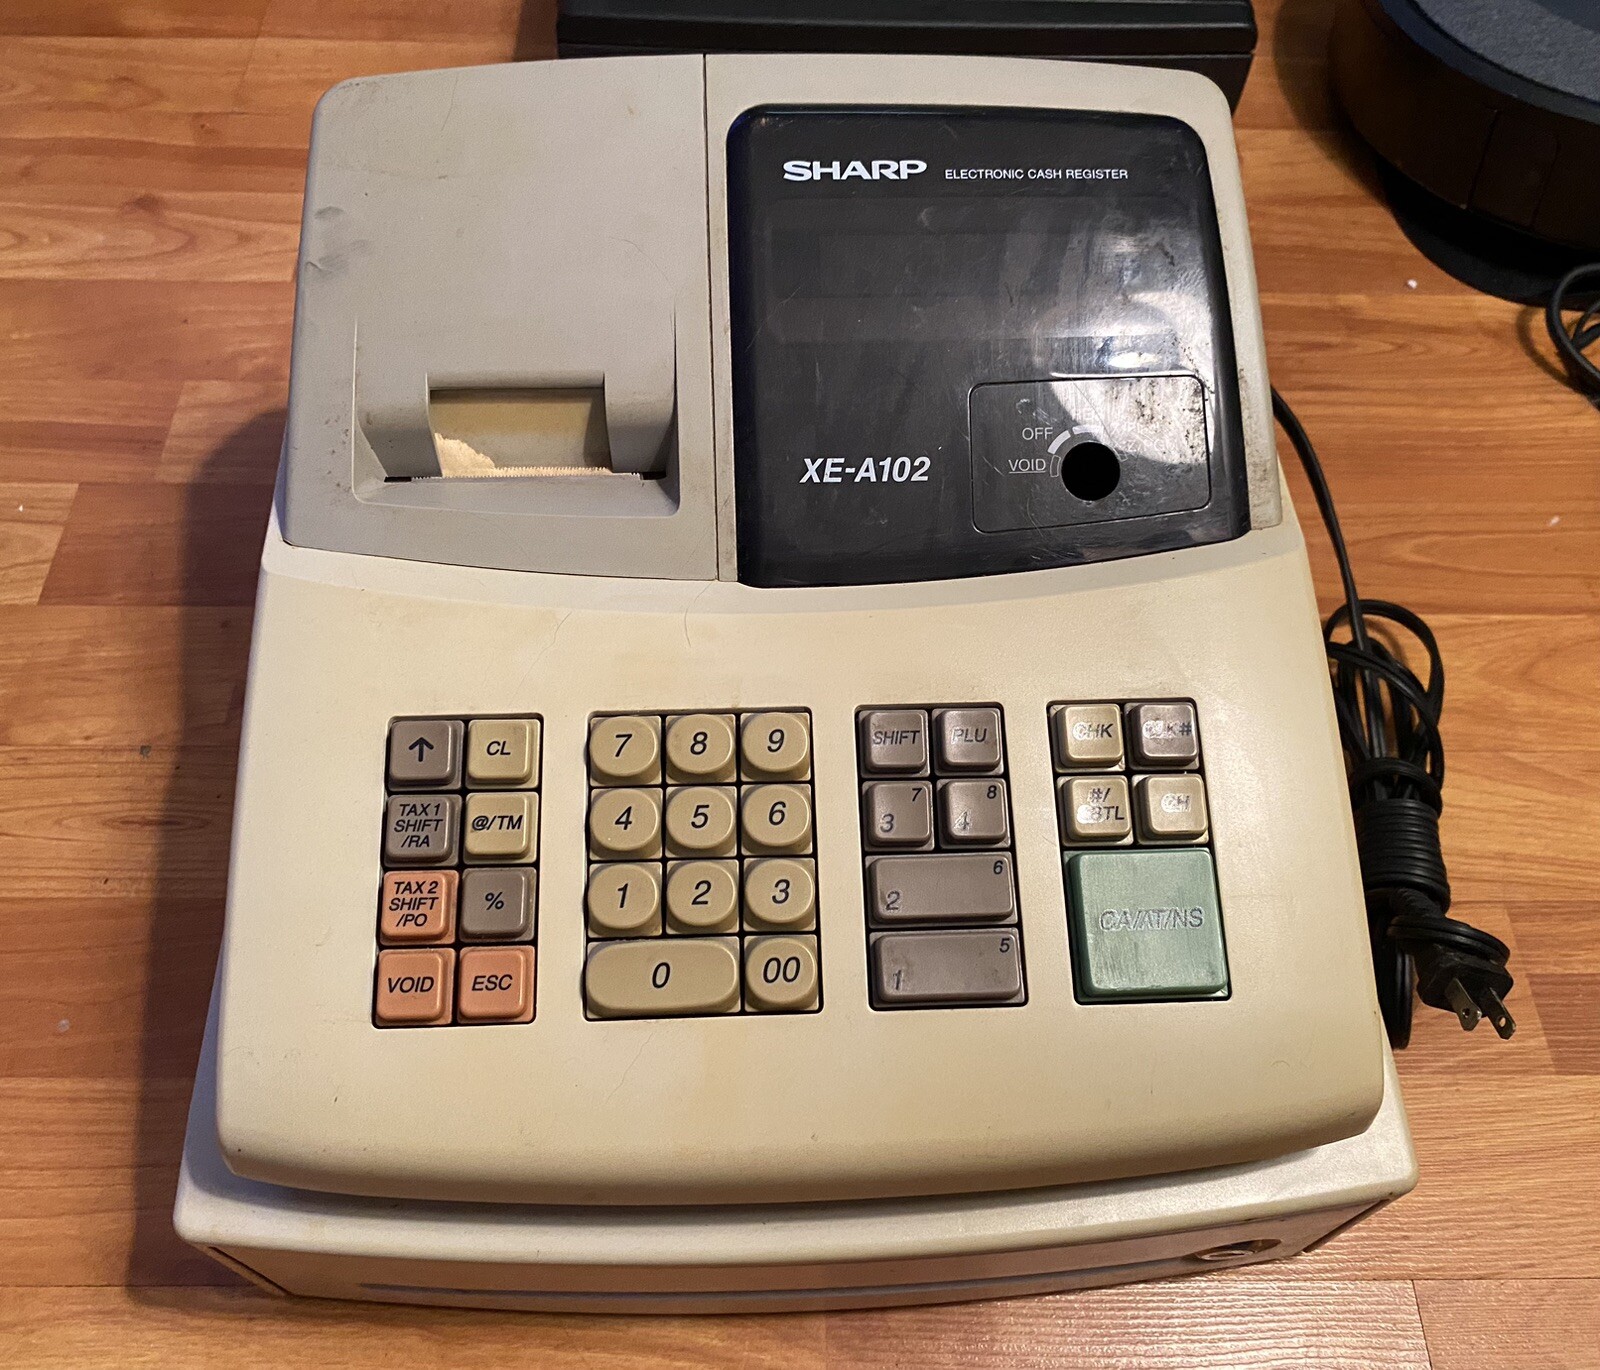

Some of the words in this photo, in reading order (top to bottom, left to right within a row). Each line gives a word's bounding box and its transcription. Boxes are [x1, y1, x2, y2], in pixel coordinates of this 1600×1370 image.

[783, 159, 928, 181] SHARP
[944, 168, 1024, 180] ELECTRONIC
[1027, 168, 1062, 180] CASH
[1065, 168, 1129, 180] REGISTER
[1022, 427, 1053, 441] OFF
[799, 456, 931, 484] XE-A102
[1008, 458, 1046, 472] VOID
[614, 733, 633, 758] 7
[689, 731, 708, 756] 8
[766, 728, 785, 753] 9
[872, 730, 920, 745] SHIFT
[952, 728, 987, 744] PLU
[486, 740, 511, 756] CL
[911, 787, 923, 802] 7
[986, 785, 998, 800] 8
[471, 815, 523, 831] @/TM
[614, 805, 633, 831] 4
[690, 804, 710, 829] 5
[768, 801, 787, 826] 6
[880, 813, 895, 833] 3
[393, 818, 443, 833] SHIFT
[400, 835, 430, 848] /RA
[993, 860, 1004, 875] 6
[616, 882, 629, 909] 1
[691, 879, 712, 906] 2
[771, 878, 791, 904] 3
[885, 890, 900, 911] 2
[388, 896, 439, 911] SHIFT
[484, 891, 505, 911] %
[396, 913, 428, 927] /PO
[999, 937, 1011, 953] 5
[651, 961, 671, 989] 0
[762, 956, 801, 984] 00
[387, 976, 435, 994] VOID
[471, 974, 513, 992] ESC
[892, 969, 902, 991] 1
